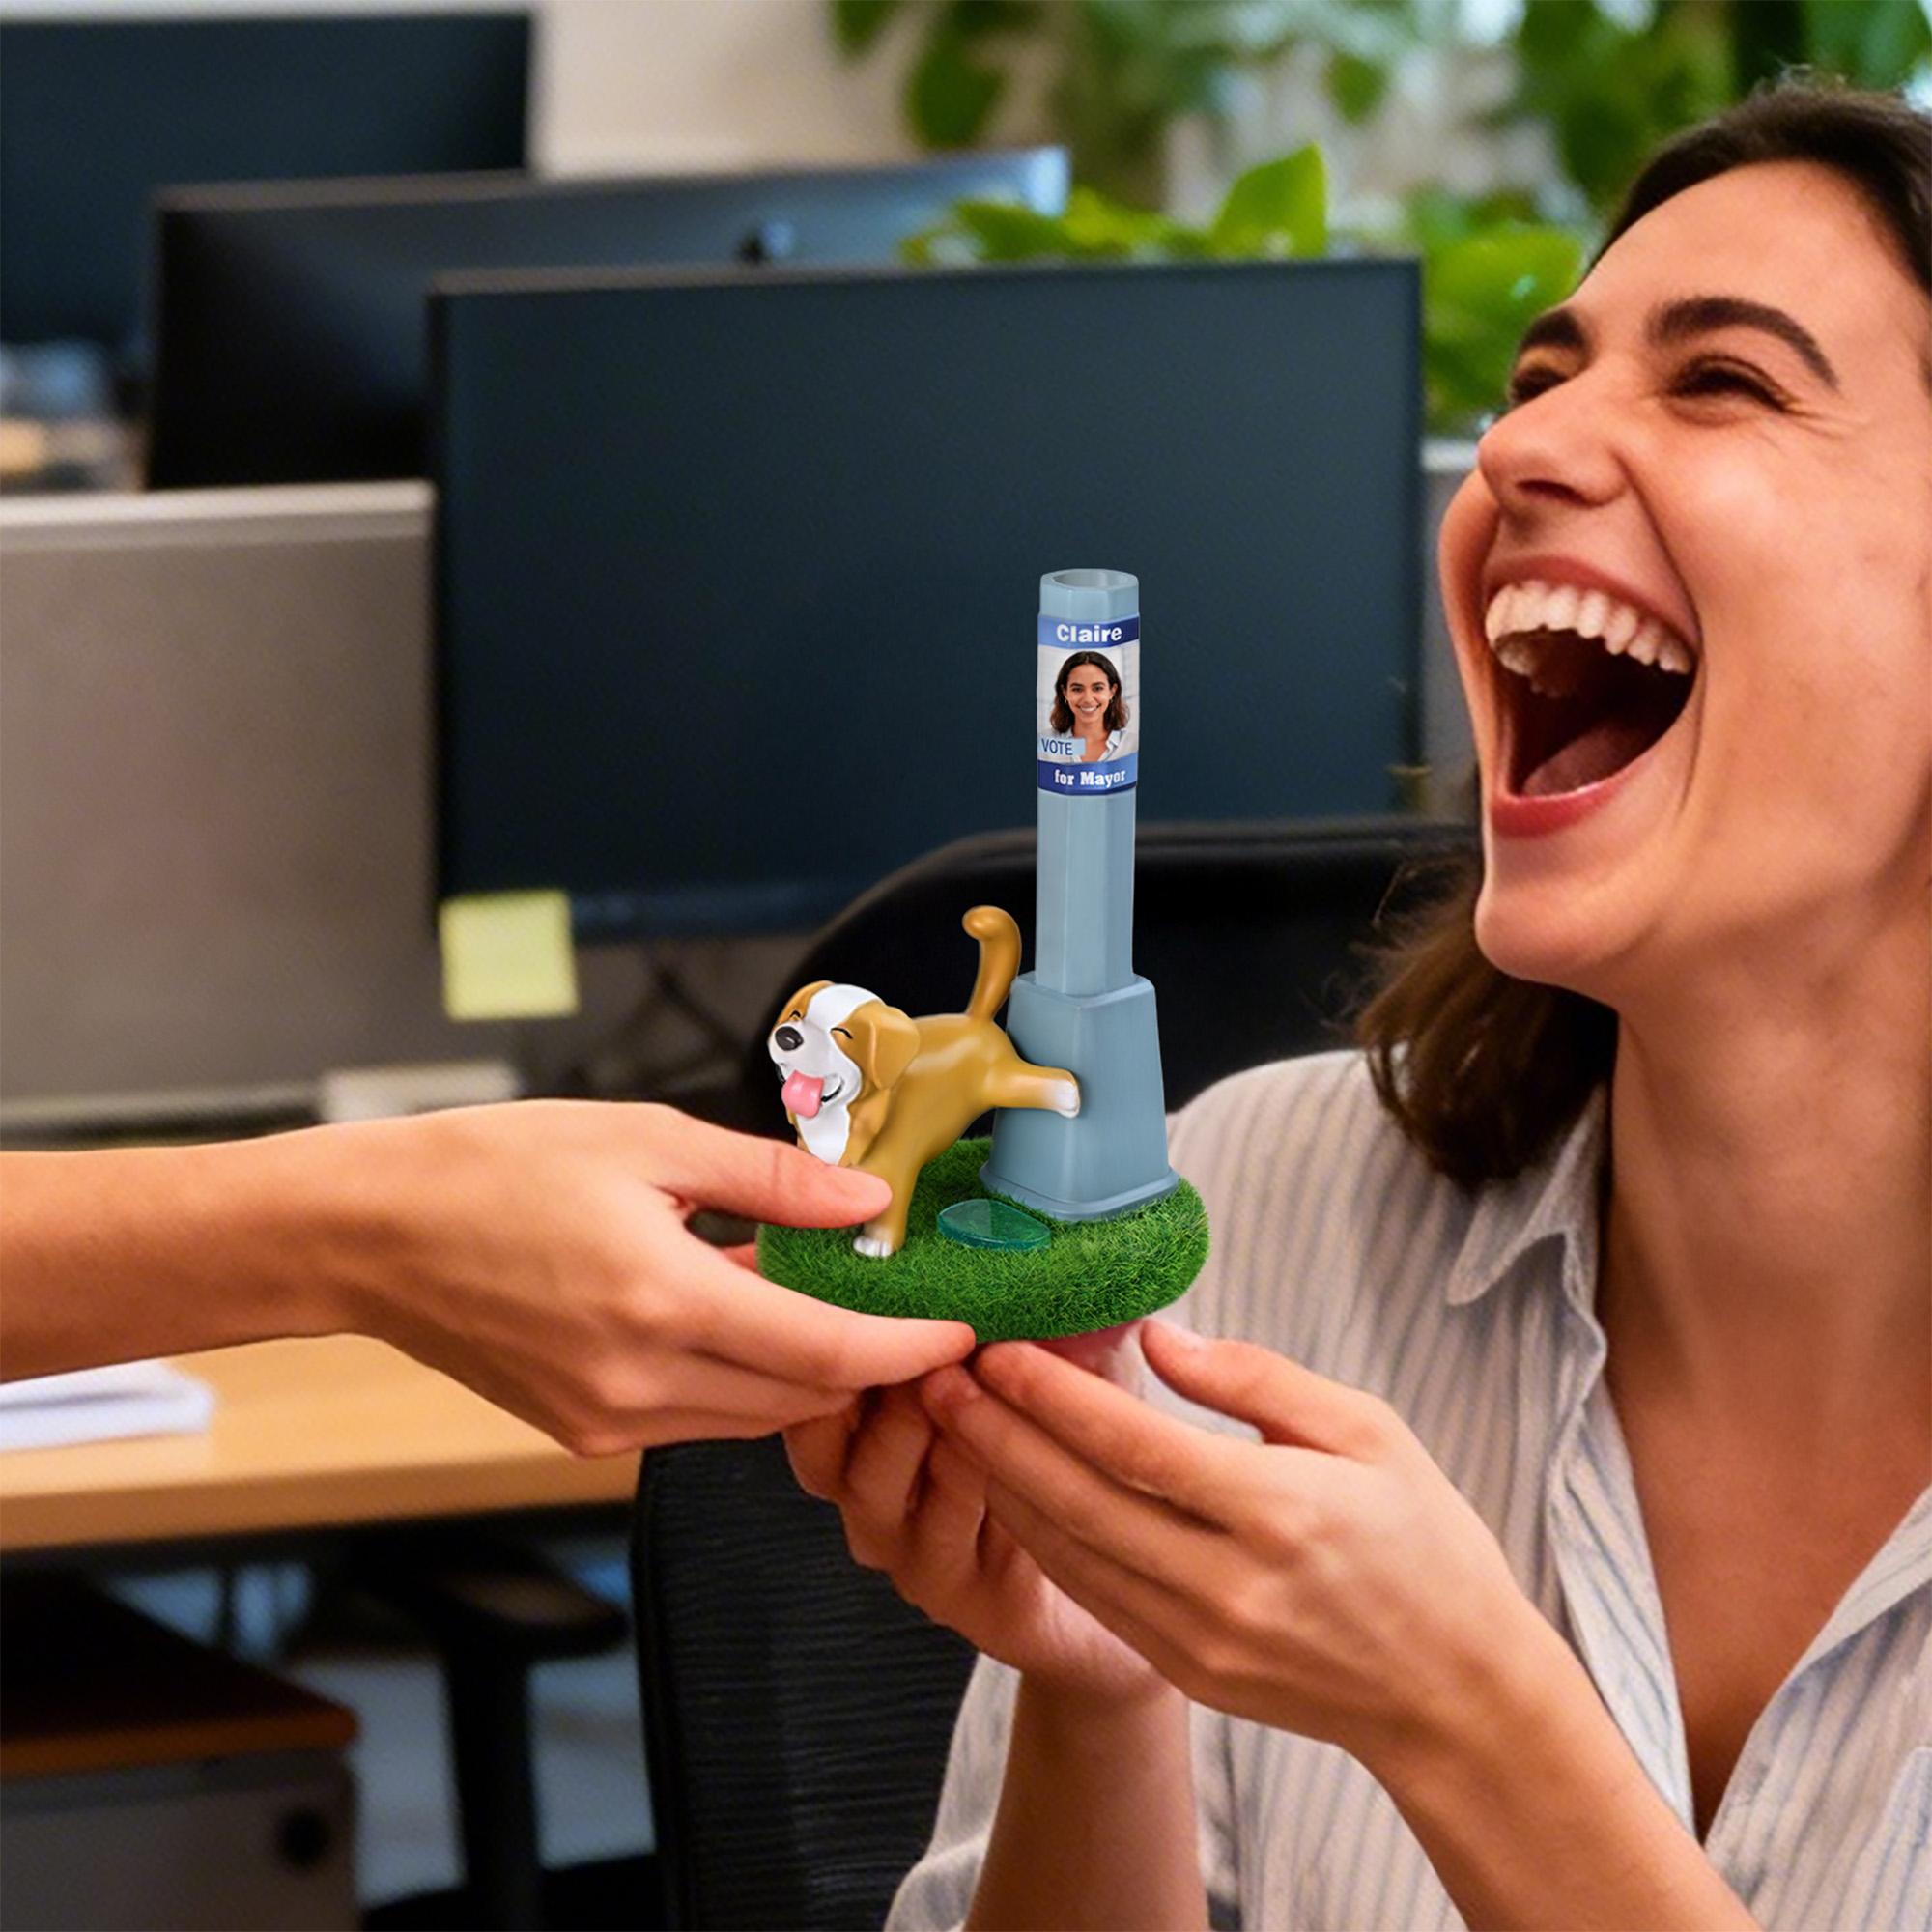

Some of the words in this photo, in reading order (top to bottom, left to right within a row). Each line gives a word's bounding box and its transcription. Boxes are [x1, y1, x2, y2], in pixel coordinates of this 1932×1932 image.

[1057, 624, 1122, 642] Claire
[1041, 738, 1073, 755] VOTE
[1054, 769, 1074, 785] for
[1080, 770, 1125, 788] Mayor
